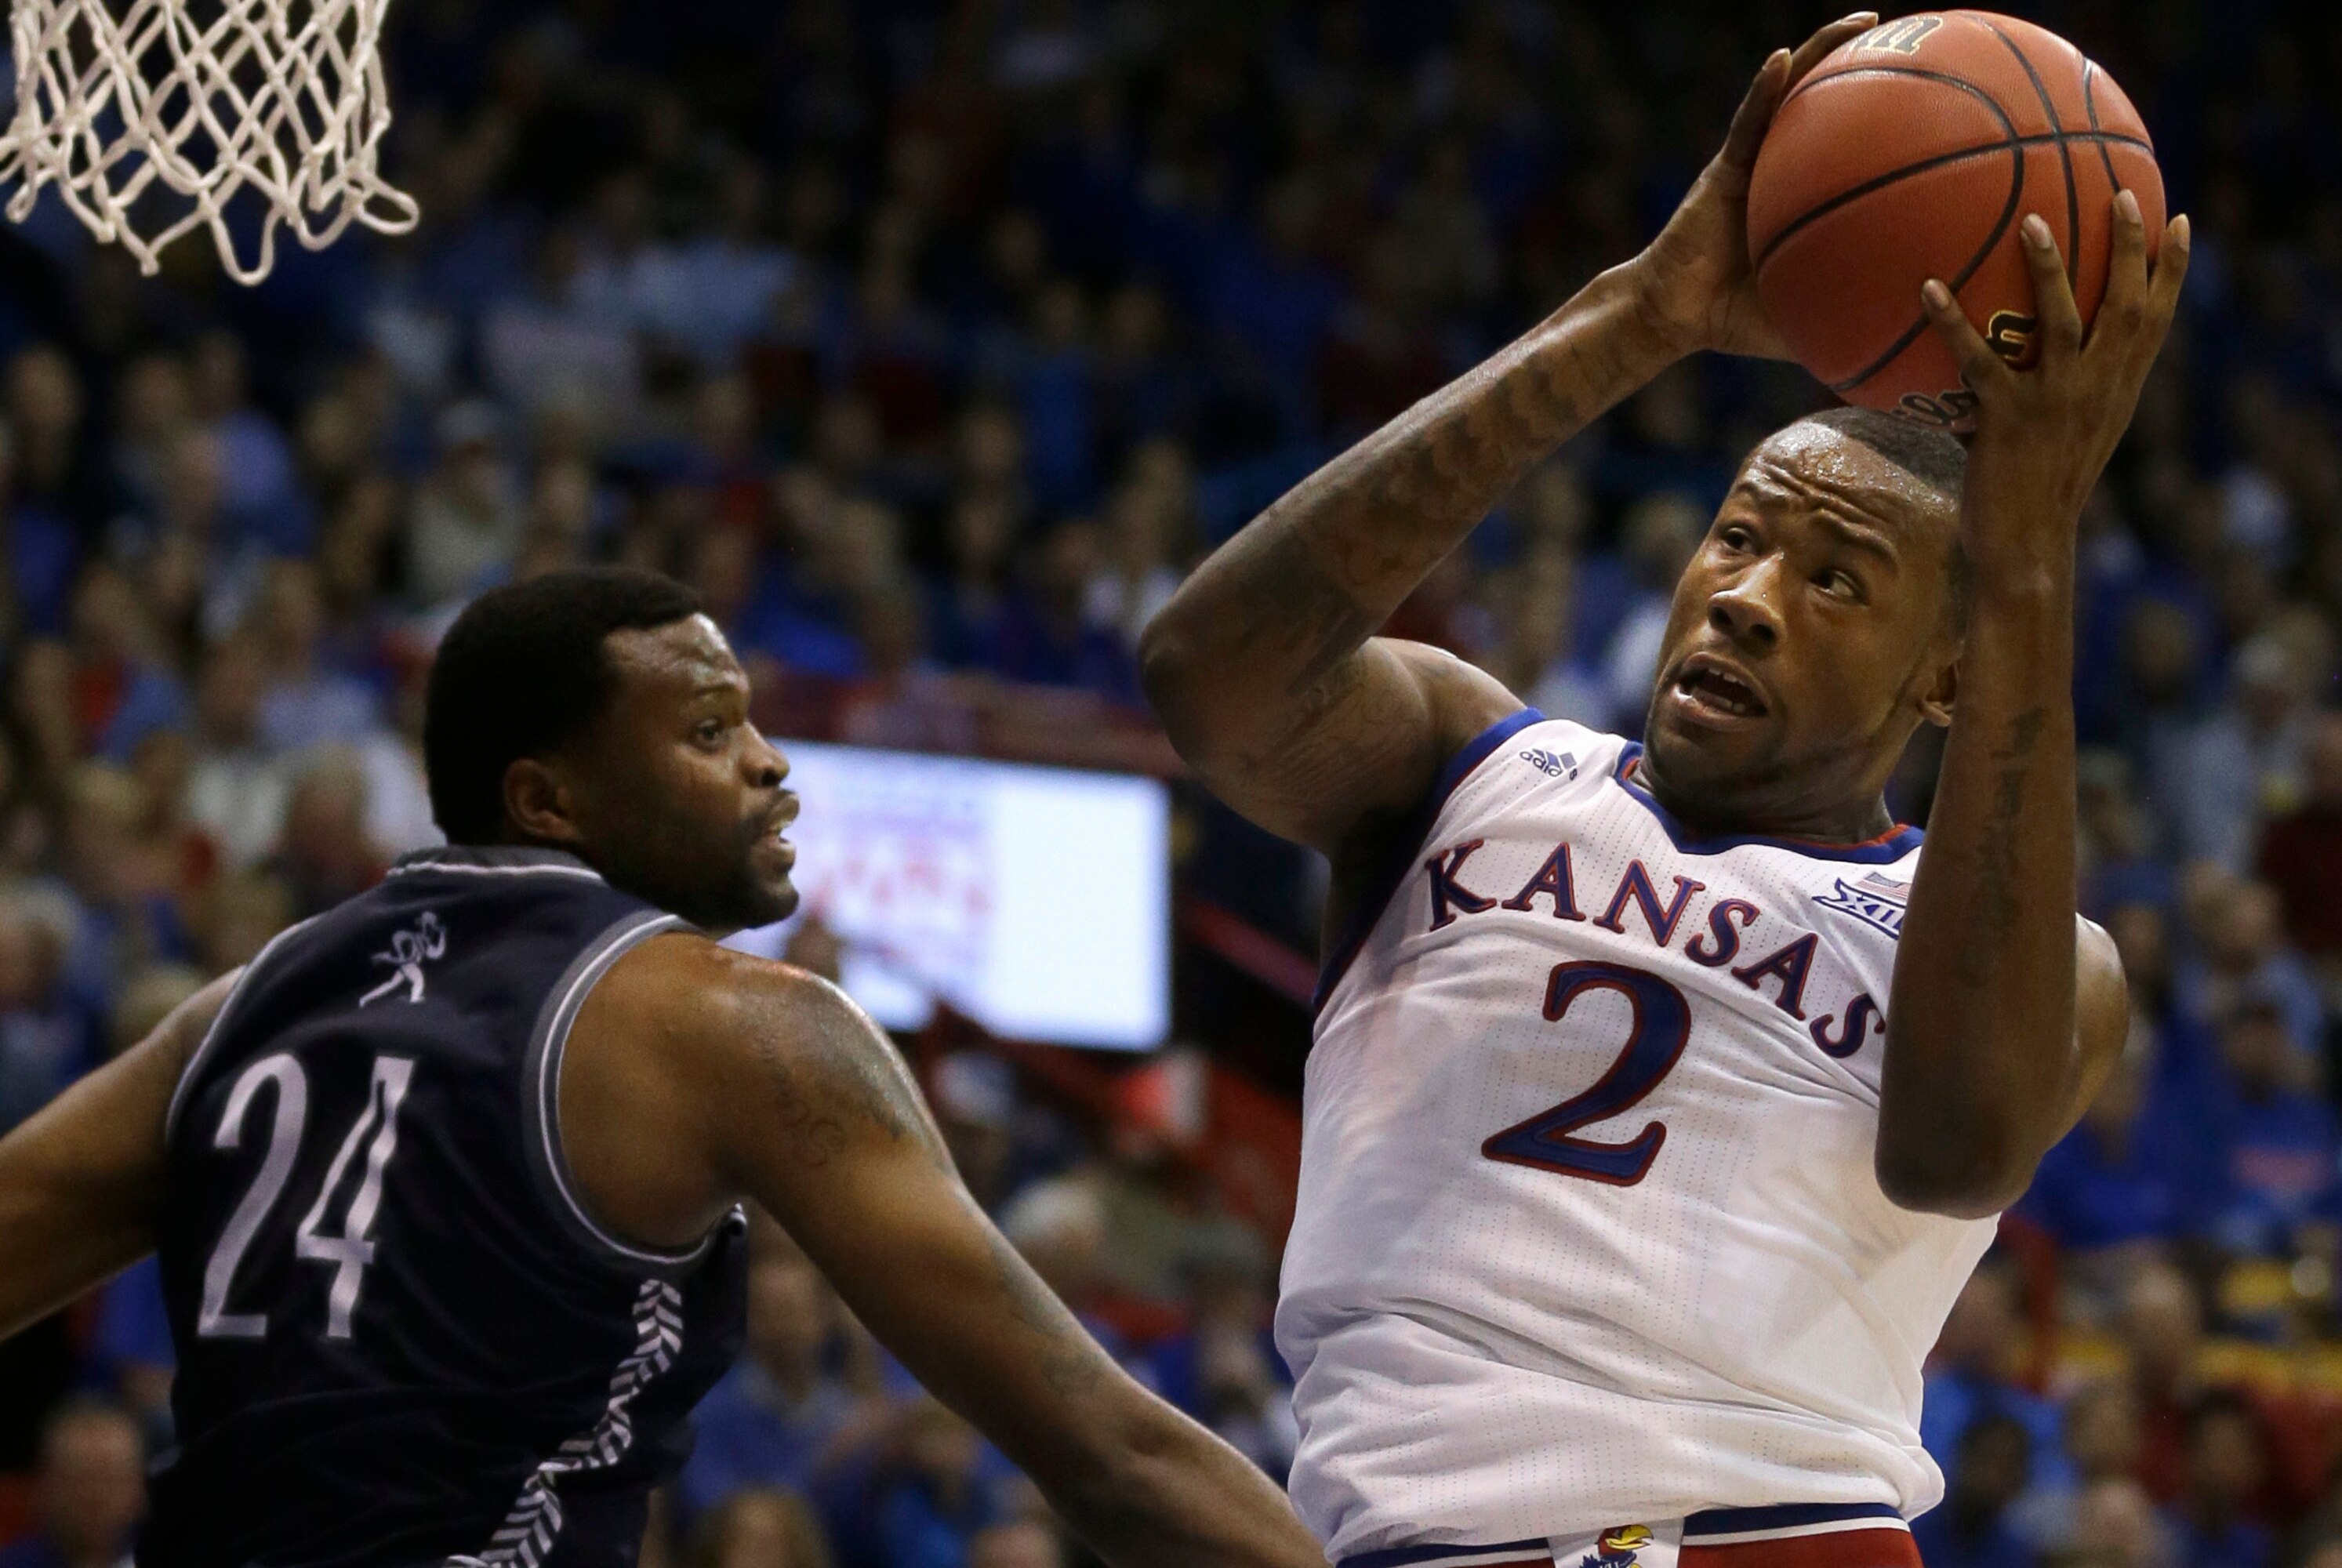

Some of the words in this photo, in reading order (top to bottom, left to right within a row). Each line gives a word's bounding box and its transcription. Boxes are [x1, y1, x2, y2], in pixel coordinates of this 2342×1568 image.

[1424, 838, 1886, 1058] KANSAS
[1481, 960, 1691, 1186] 2
[198, 1052, 415, 1338] 24
